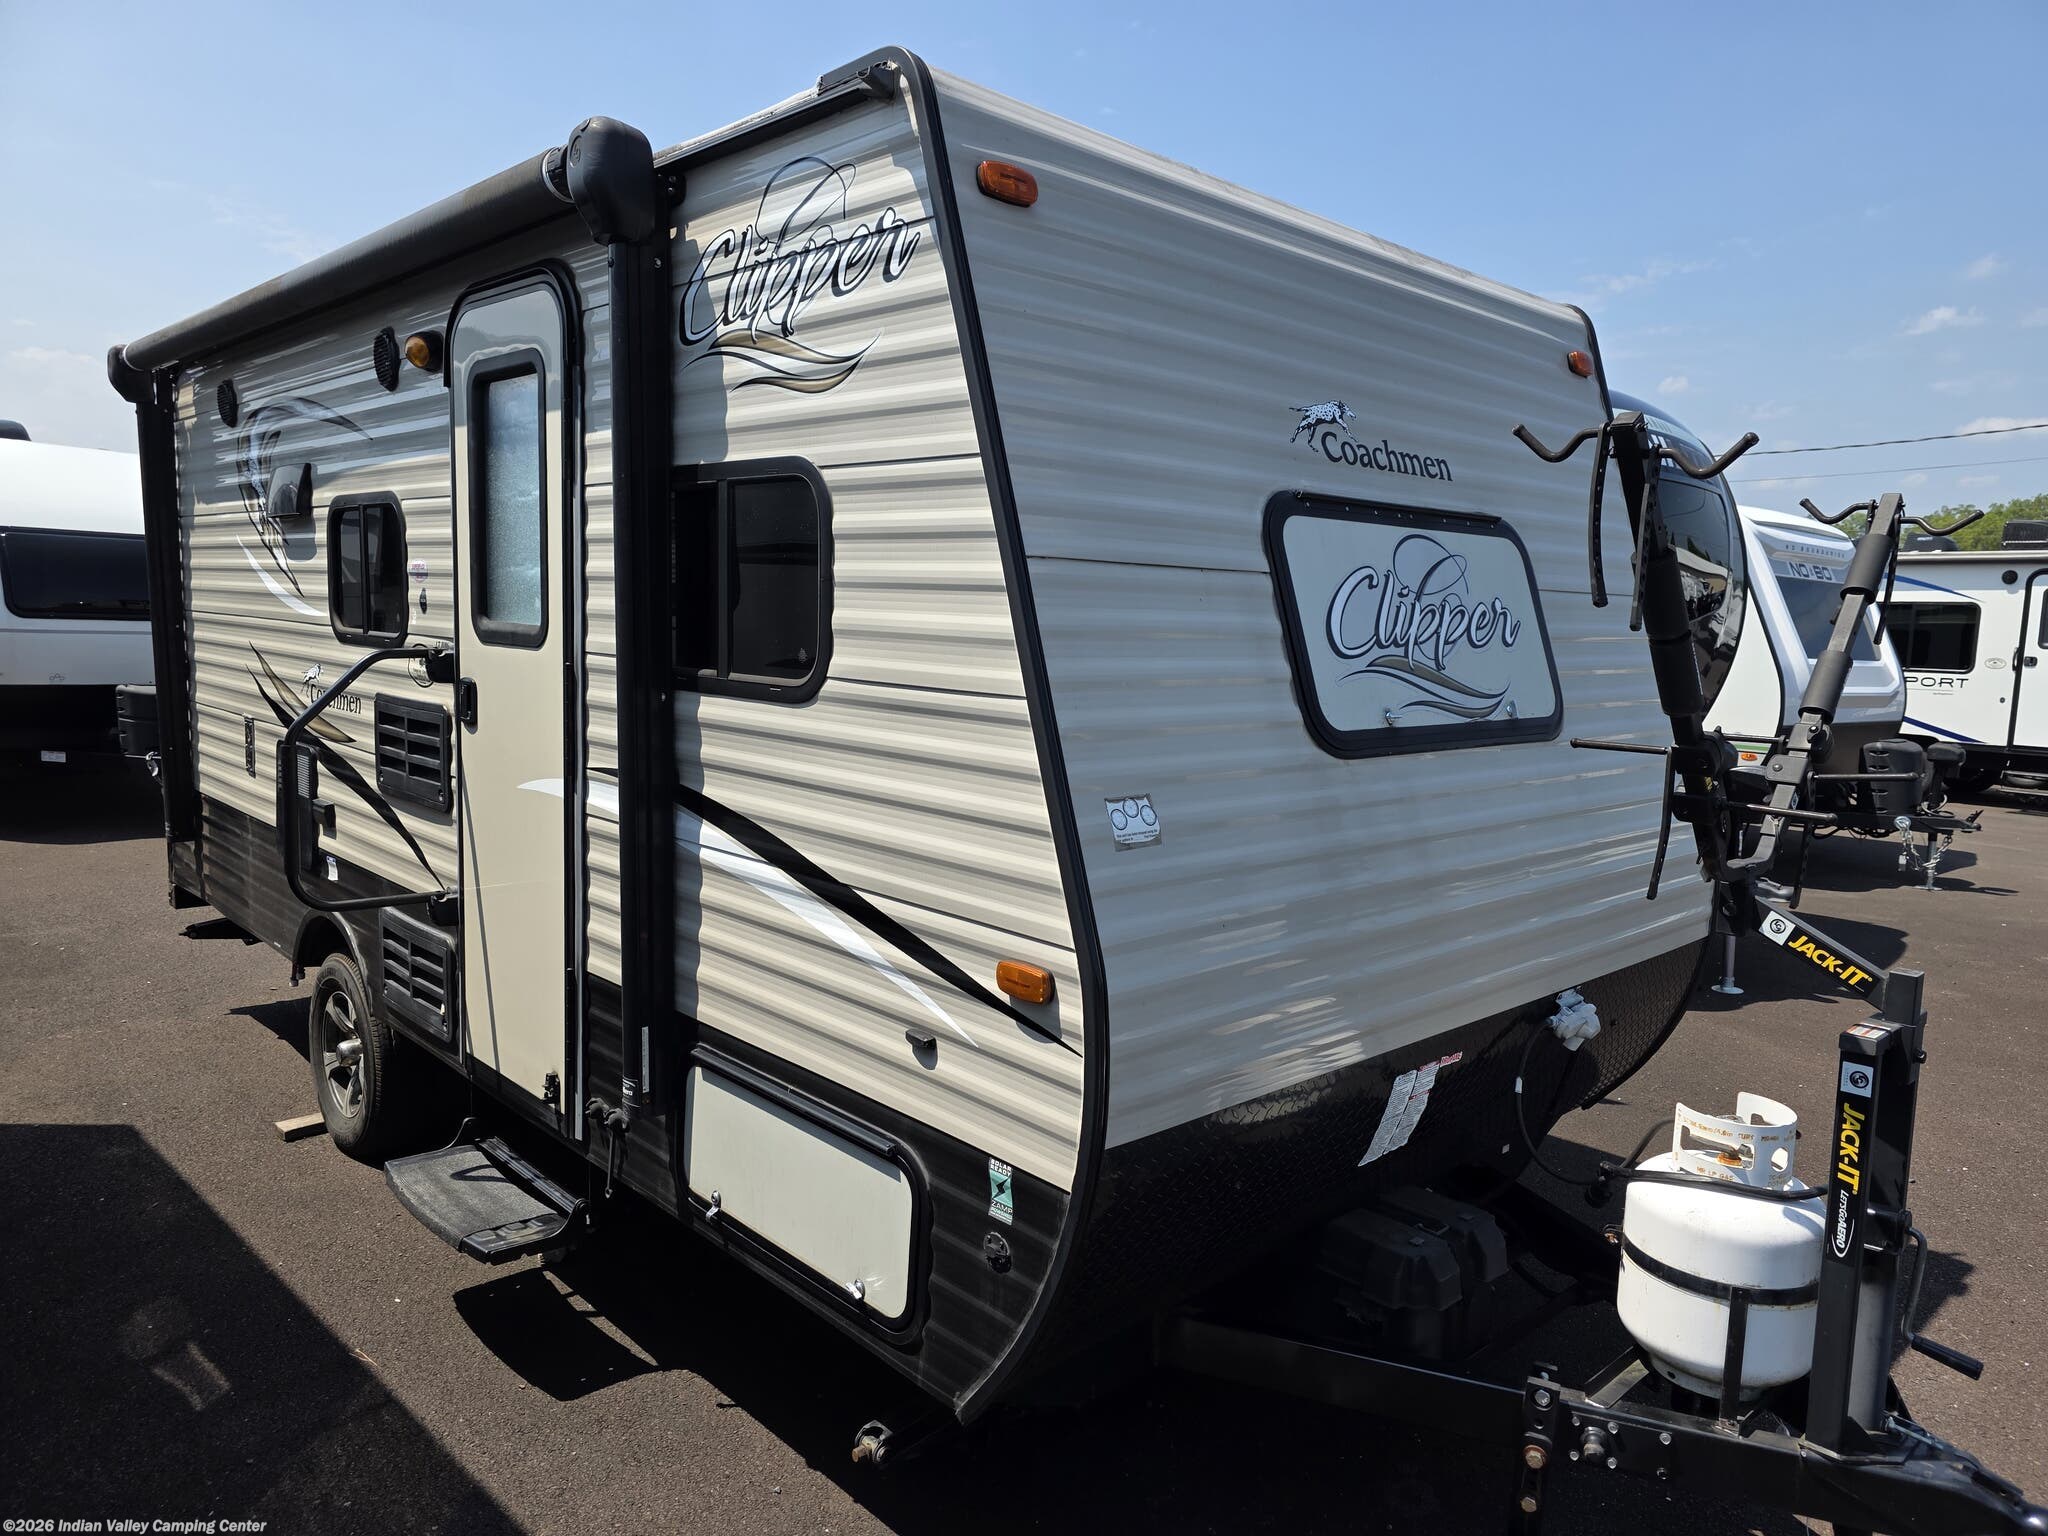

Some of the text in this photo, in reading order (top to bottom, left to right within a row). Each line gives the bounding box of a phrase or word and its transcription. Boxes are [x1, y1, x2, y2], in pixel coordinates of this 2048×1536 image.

[679, 157, 921, 346] Clipper
[1320, 431, 1454, 482] Coachmen
[1326, 534, 1521, 671] Clipper
[1788, 935, 1871, 986] JACK-IT
[990, 1164, 1012, 1177] READY
[991, 1159, 1012, 1171] SOLAR
[1837, 1102, 1866, 1192] JACK-IT
[991, 1200, 1013, 1214] ZAMP
